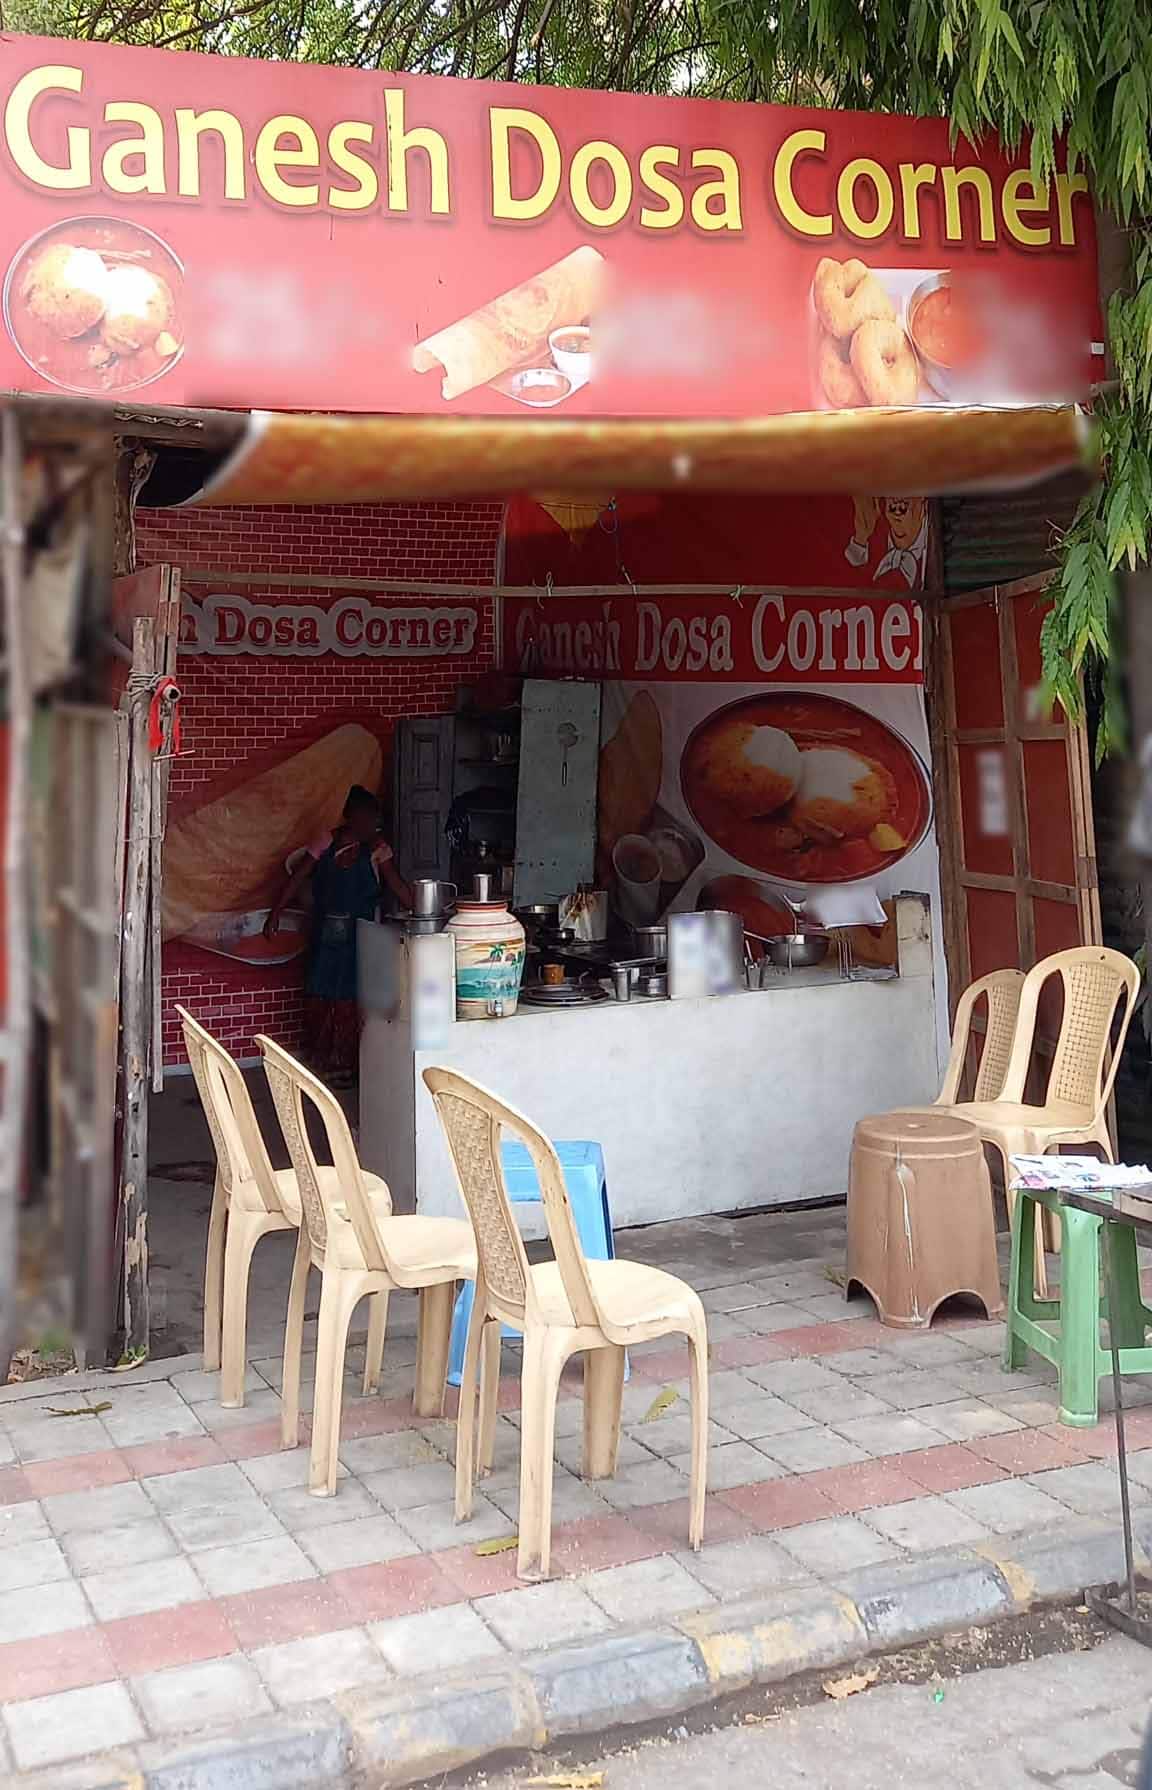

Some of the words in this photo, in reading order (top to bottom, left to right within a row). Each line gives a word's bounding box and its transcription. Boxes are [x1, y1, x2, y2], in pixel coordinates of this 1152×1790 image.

[4, 64, 450, 214] Ganesh
[489, 107, 743, 231] Dosa
[773, 129, 1088, 246] Corner
[215, 606, 320, 648] Dosa
[335, 608, 471, 647] Corner
[634, 602, 734, 672] Dosa
